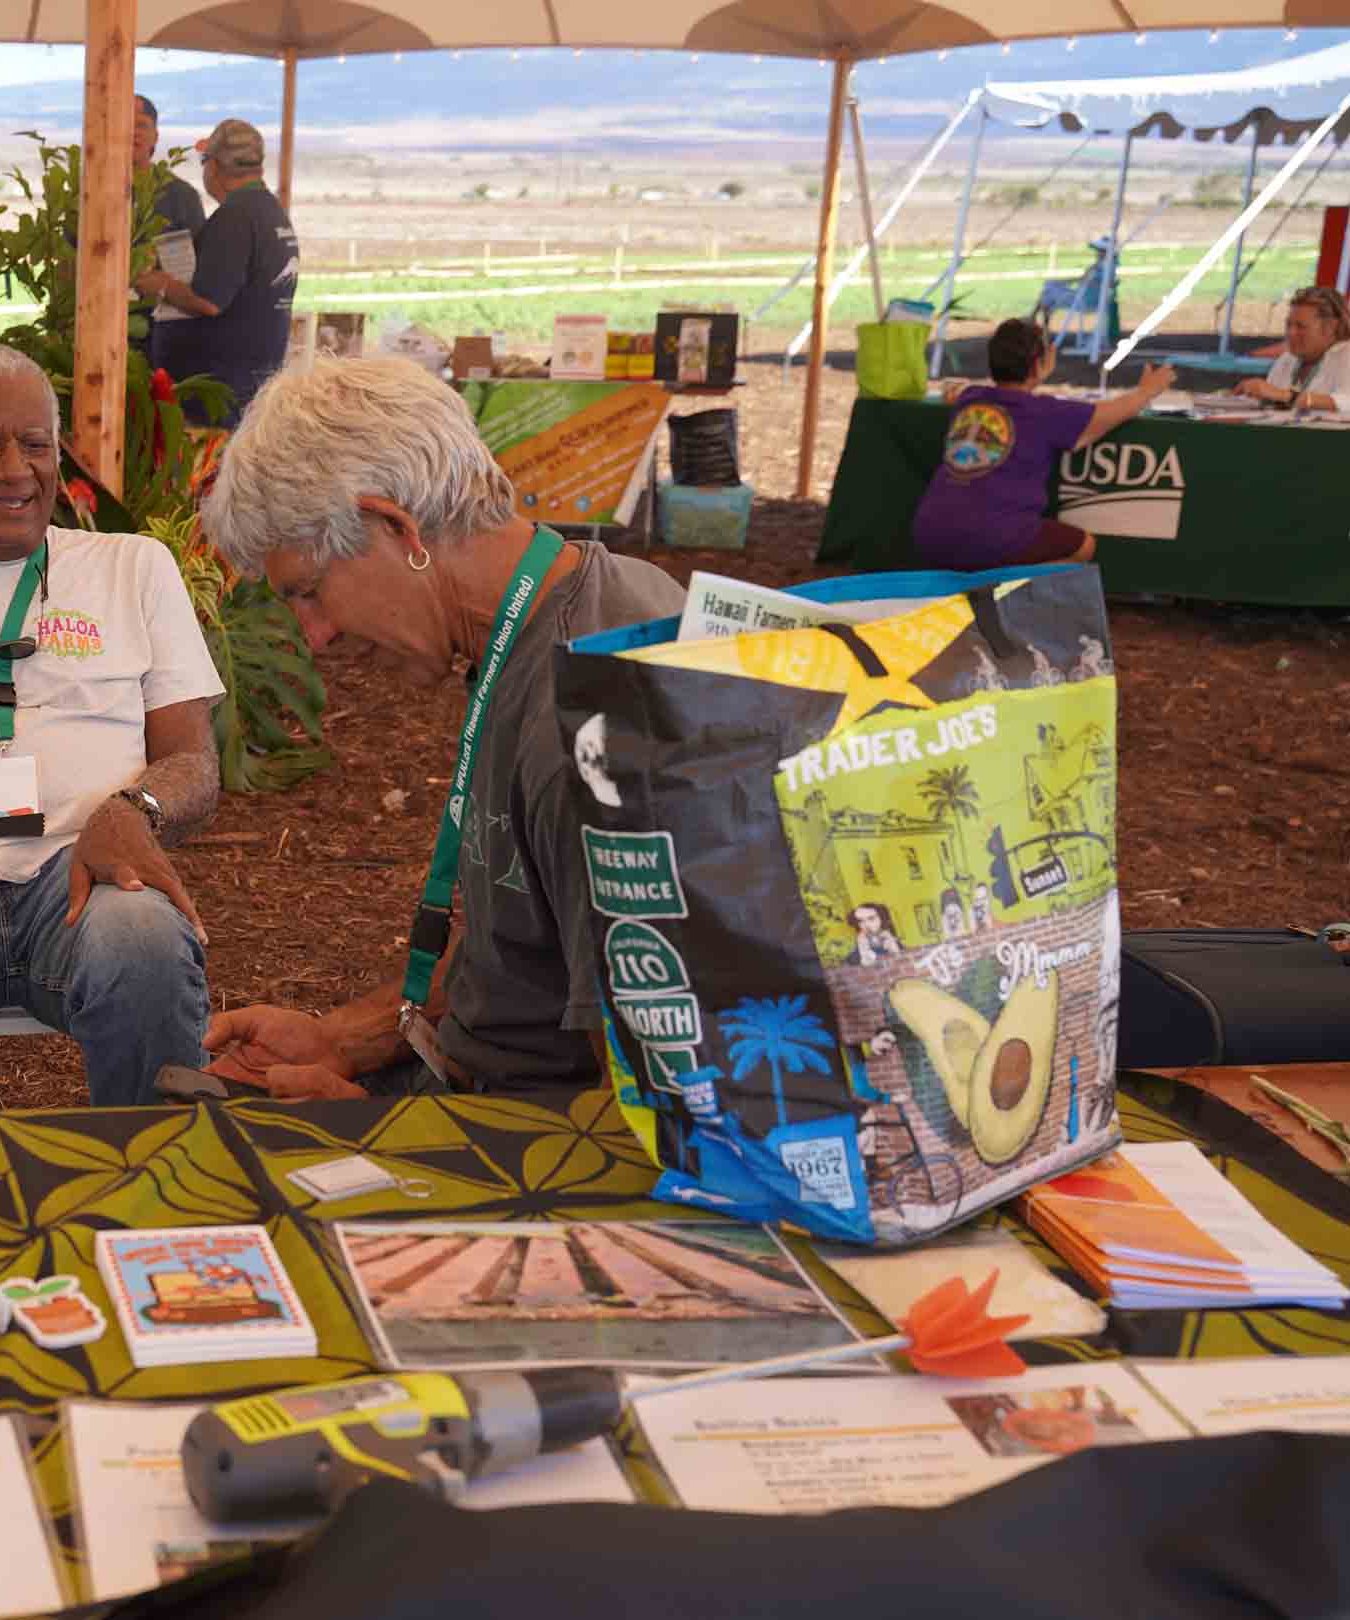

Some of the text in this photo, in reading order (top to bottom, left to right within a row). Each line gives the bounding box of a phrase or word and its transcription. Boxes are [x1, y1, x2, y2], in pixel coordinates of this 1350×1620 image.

[1059, 442, 1186, 488] USDA
[478, 653, 500, 701] Farmers
[493, 619, 515, 653] Union
[506, 575, 535, 619] United)
[777, 728, 923, 792] TRADER
[595, 877, 674, 900] NTRANCE
[614, 952, 670, 984] 110
